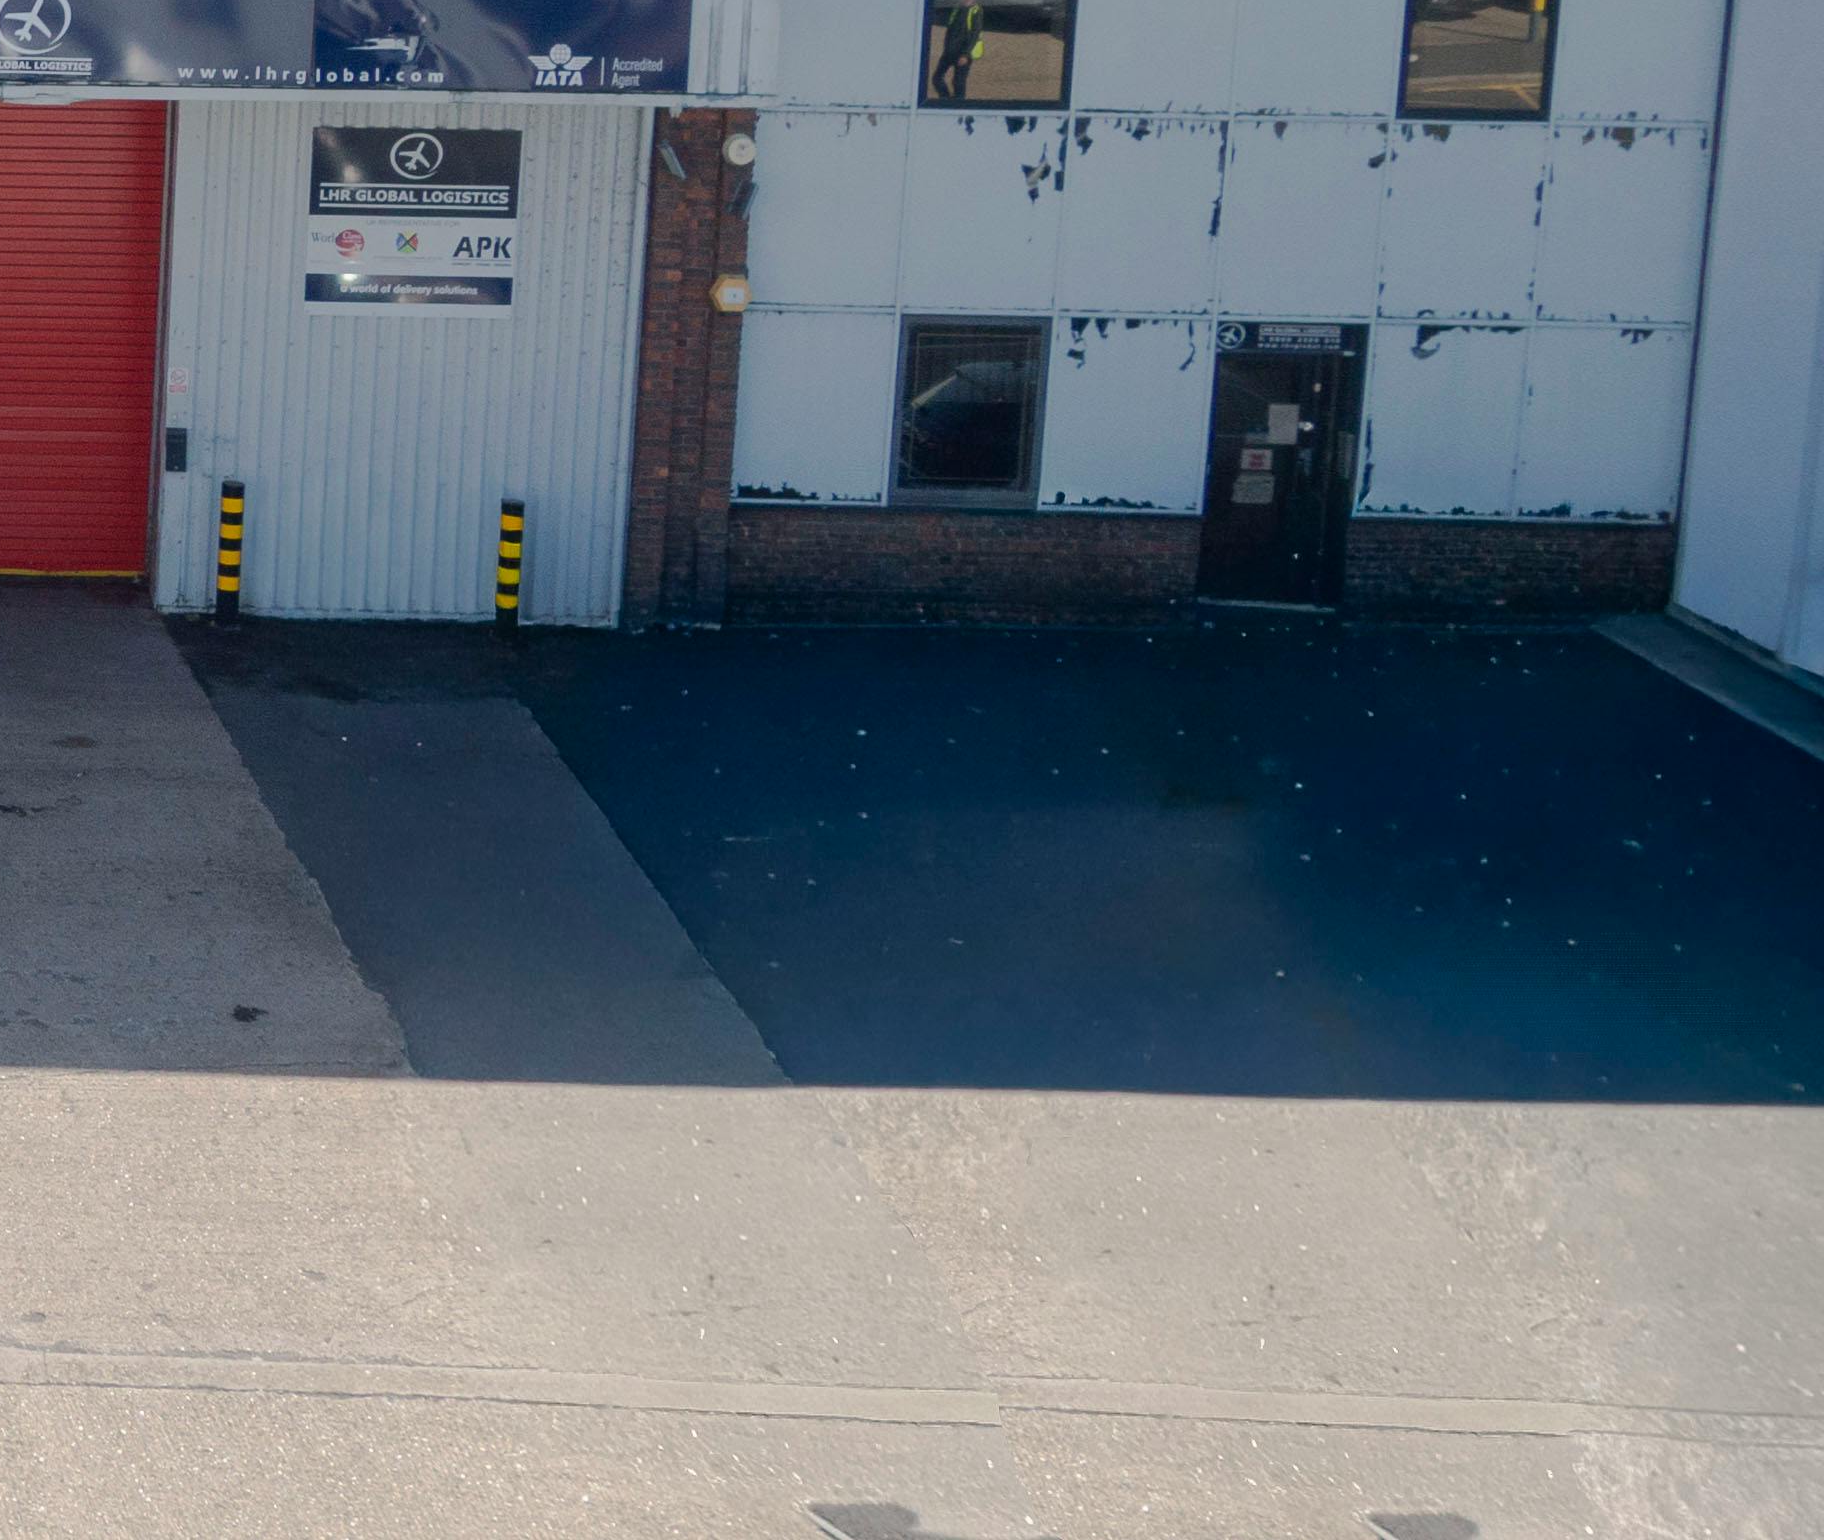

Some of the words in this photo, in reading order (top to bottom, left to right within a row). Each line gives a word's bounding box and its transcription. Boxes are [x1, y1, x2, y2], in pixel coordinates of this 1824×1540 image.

[34, 61, 93, 72] LOGISTICS
[612, 57, 663, 72] Accredited
[177, 66, 445, 85] www.lhrglobal.com
[535, 70, 584, 87] IATA
[611, 72, 641, 88] Agent
[319, 188, 352, 202] LHR
[355, 189, 418, 204] GLOBAL
[422, 190, 510, 205] LOGISTICS
[452, 236, 512, 259] APK
[350, 284, 379, 294] world
[380, 284, 392, 294] of
[393, 284, 433, 296] delivery
[433, 285, 479, 296] solutions
